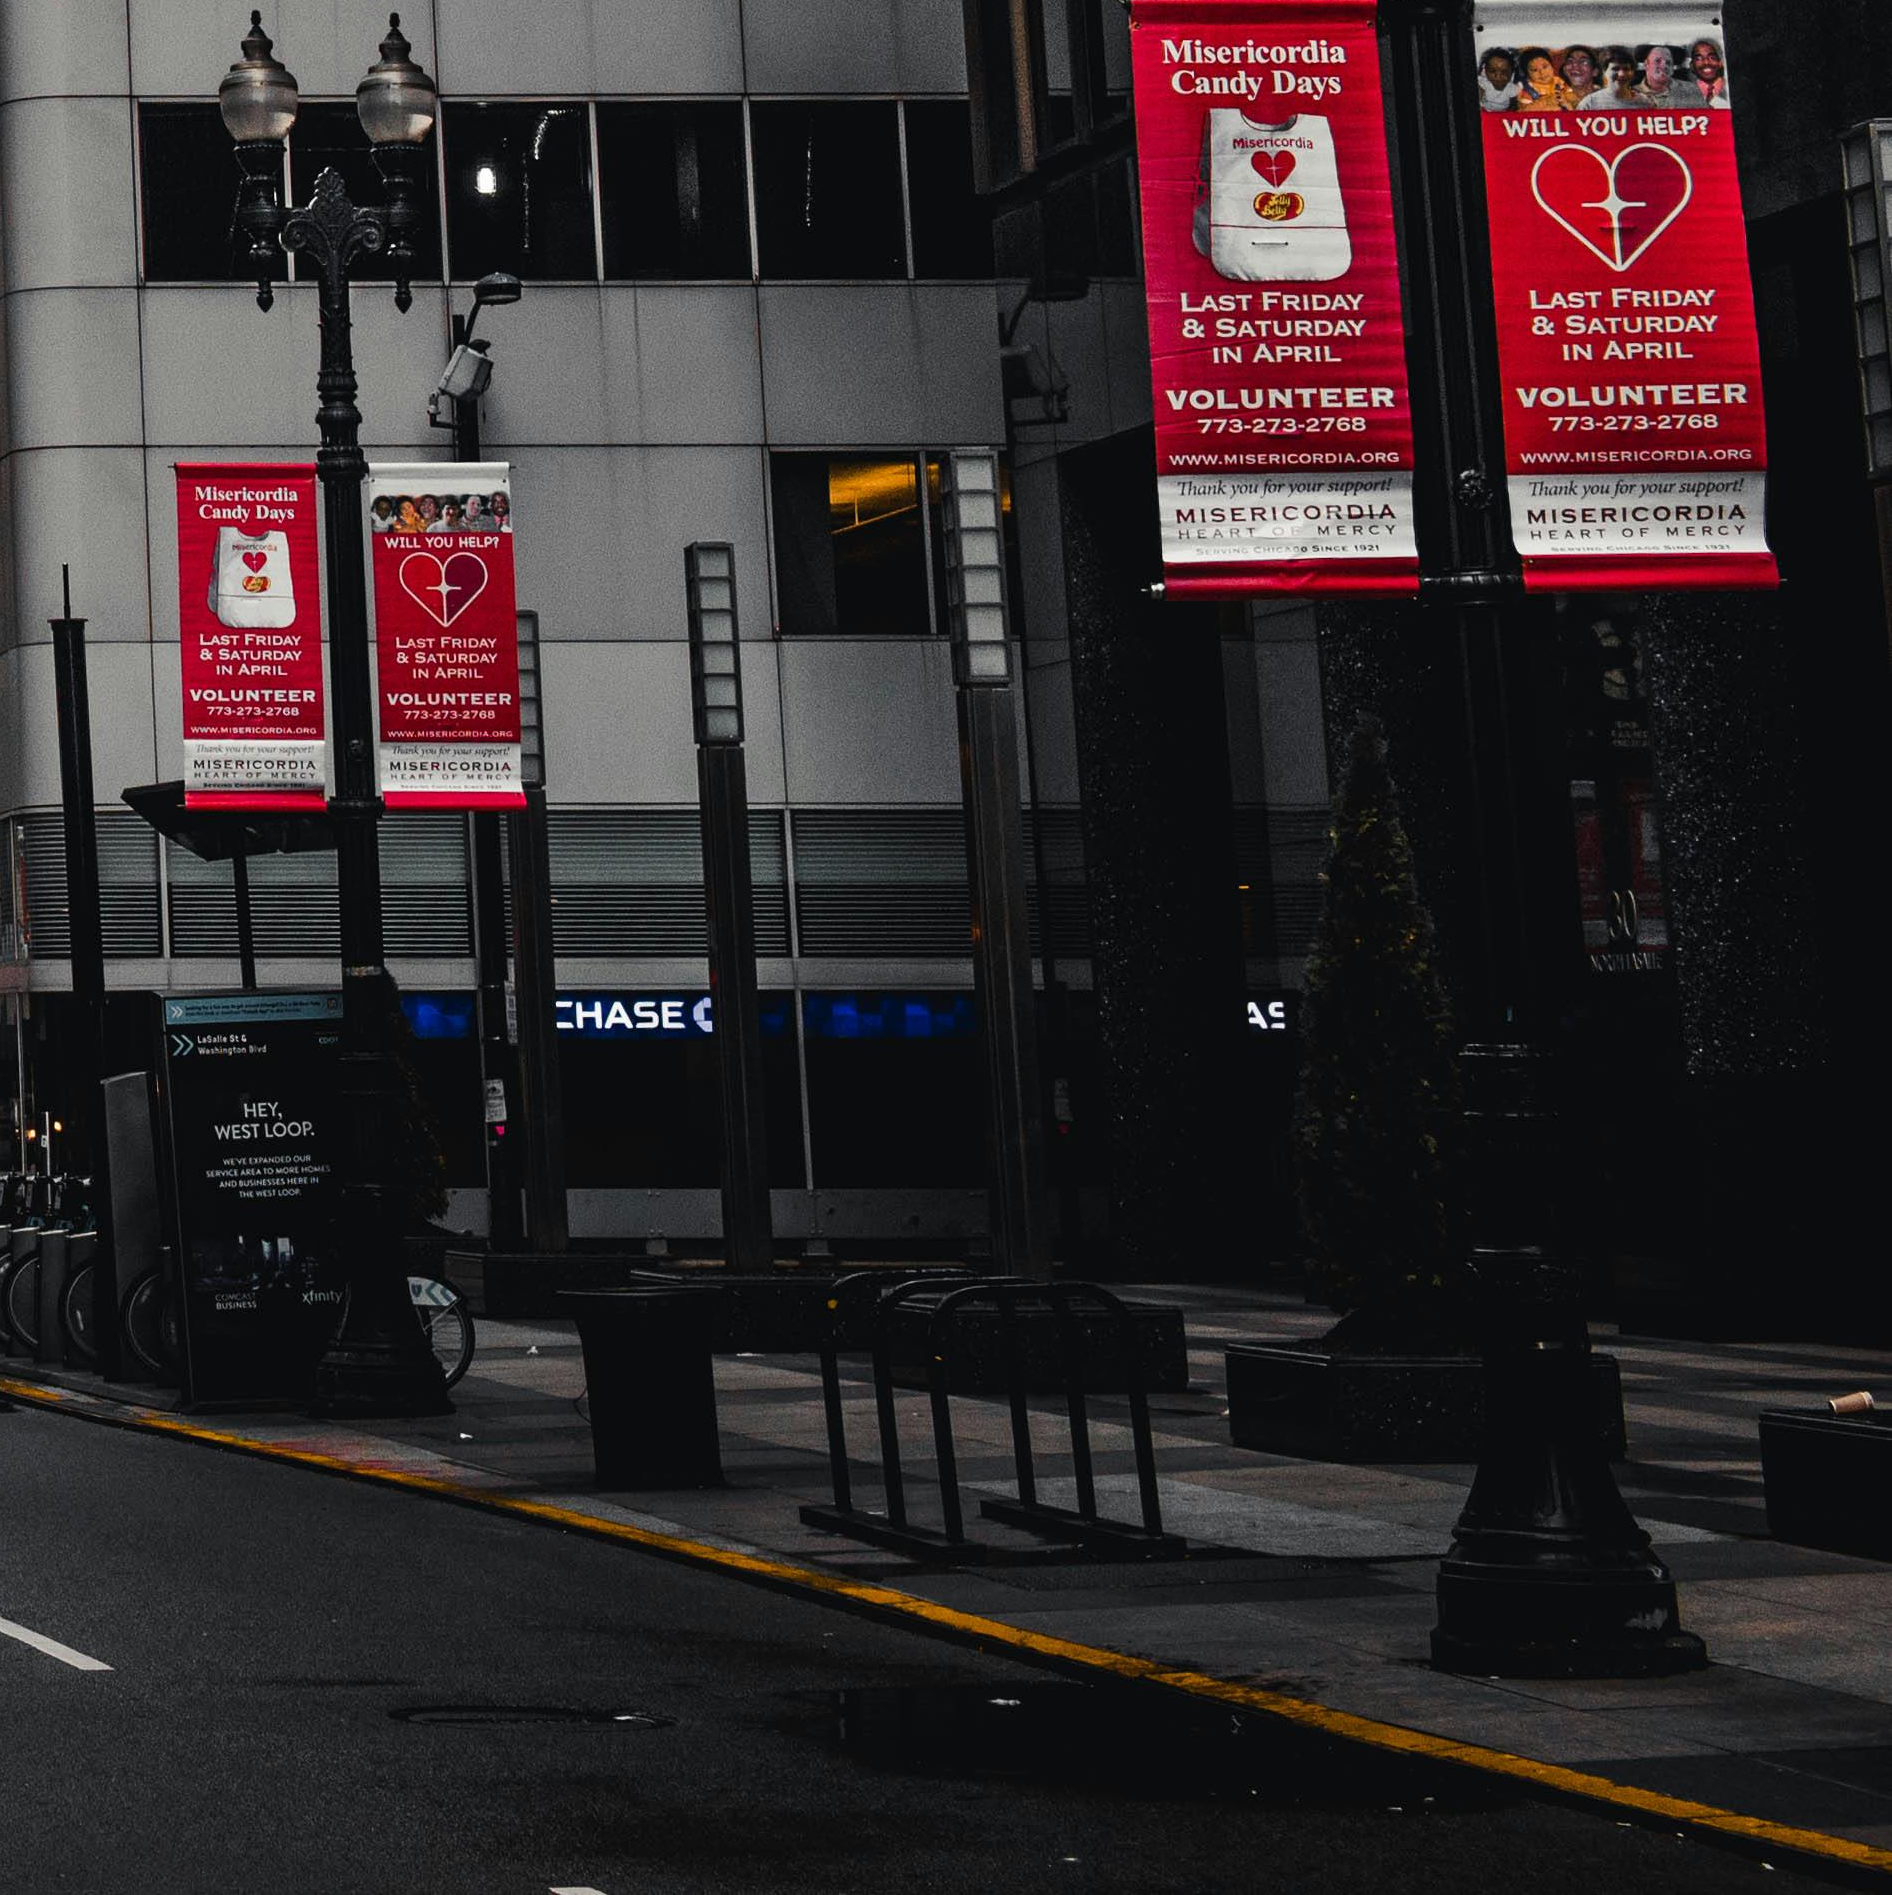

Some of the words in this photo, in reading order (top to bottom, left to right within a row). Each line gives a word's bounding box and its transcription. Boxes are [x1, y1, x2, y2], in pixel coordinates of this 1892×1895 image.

[1161, 40, 1346, 64] Misericordia
[1171, 70, 1263, 100] Candy
[1271, 70, 1341, 100] Days
[1503, 119, 1569, 137] WILL
[1577, 117, 1627, 136] YOU
[1637, 116, 1709, 136] HELP?
[1233, 136, 1314, 149] Misericordia
[1269, 194, 1290, 207] Jelly
[1262, 206, 1288, 216] Belly
[1180, 293, 1252, 312] LAST
[1262, 291, 1364, 311] FRIDAY
[1529, 290, 1602, 310] LAST
[1612, 288, 1716, 308] FRIDAY
[1182, 320, 1205, 338] &
[1215, 319, 1366, 338] SATURDAY
[1532, 316, 1555, 335] &
[1565, 315, 1718, 335] SATURDAY
[1212, 346, 1242, 364] IN
[1253, 343, 1342, 362] APRIL
[1562, 344, 1592, 361] IN
[1603, 340, 1693, 360] APRIL
[1165, 387, 1395, 410] VOLUNTEER
[1516, 383, 1747, 407] VOLUNTEER
[1198, 417, 1367, 434] 773-273-2768
[1548, 414, 1719, 431] 773-273-2768
[1169, 452, 1400, 465] WWW.MISERICORDIA.ORG
[1520, 449, 1752, 464] WWW.MISERICORDIA.ORG
[195, 487, 298, 501] Misericordia
[1178, 480, 1226, 496] Thank
[1231, 482, 1258, 500] you
[1263, 479, 1285, 499] for
[1287, 481, 1324, 499] your
[1327, 478, 1392, 496] support!
[1528, 481, 1577, 497] Thank
[1582, 483, 1610, 499] you
[1613, 481, 1637, 499] for
[1640, 481, 1676, 499] your
[1679, 479, 1743, 497] support!
[199, 504, 250, 523] Candy
[256, 505, 294, 523] Days
[1176, 504, 1396, 523] MISERICORDIA
[1527, 504, 1746, 524] MISERICORDIA
[1179, 527, 1256, 539] HEART
[1318, 525, 1396, 536] MERCY
[1531, 529, 1606, 540] HEART
[1622, 528, 1650, 538] OF
[1667, 525, 1745, 536] MERCY
[385, 537, 421, 549] WILL
[426, 537, 454, 549] YOU
[459, 536, 499, 550] HELP?
[1312, 545, 1349, 553] SINCE
[200, 634, 239, 646] LAST
[245, 634, 301, 646] FRIDAY
[200, 649, 212, 660] &
[219, 649, 302, 660] SATURDAY
[216, 666, 232, 675] IN
[238, 664, 288, 675] APRIL
[190, 689, 315, 702] VOLUNTEER
[387, 693, 511, 705] VOLUNTEER
[207, 707, 299, 716] 773-273-2768
[194, 760, 315, 769] MISERICORDIA
[390, 762, 511, 771] MISERICORDIA
[556, 1001, 686, 1028] CHASE
[197, 1035, 227, 1044] LaSalle
[229, 1035, 239, 1043] St
[197, 1046, 247, 1056] Washington
[249, 1044, 267, 1053] Blvd
[243, 1102, 282, 1119] HEY,
[215, 1124, 260, 1140] WEST
[264, 1121, 315, 1137] LOOP.
[249, 1156, 291, 1165] EXPANDED
[206, 1169, 238, 1177] SERVICE
[240, 1168, 261, 1176] AREA
[276, 1166, 299, 1174] MORE
[239, 1178, 285, 1187] BUSINESSES
[215, 1301, 257, 1310] BUSINESS
[302, 1290, 344, 1306] xfinity
